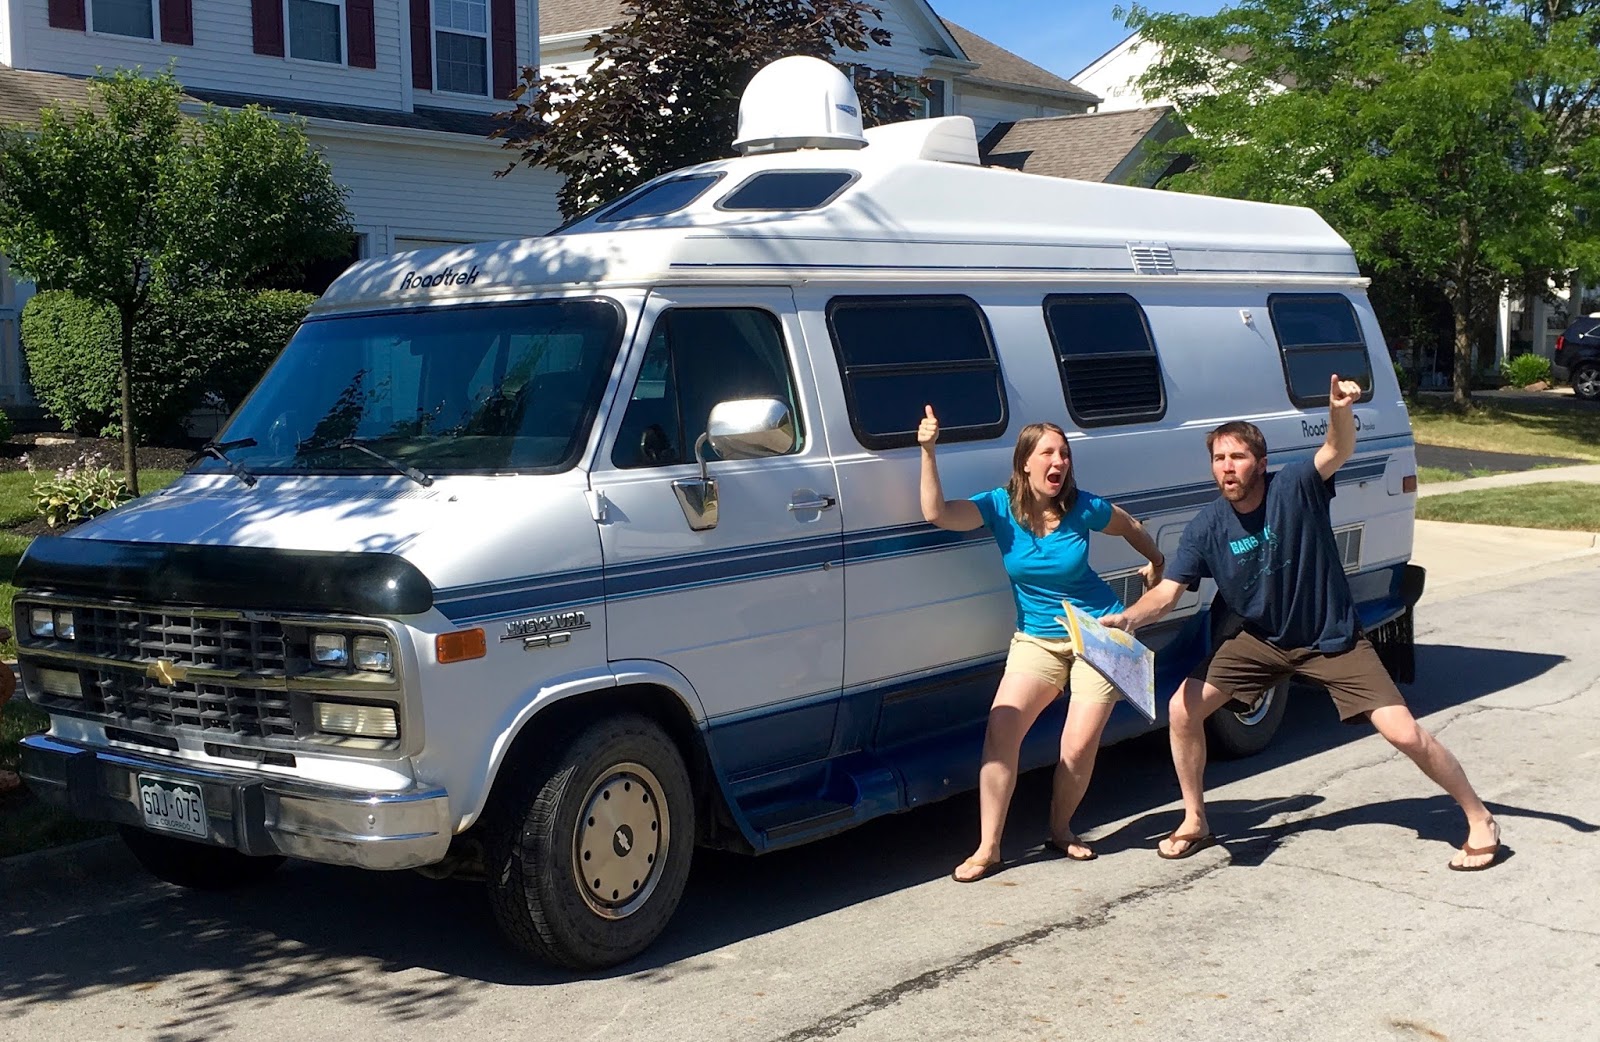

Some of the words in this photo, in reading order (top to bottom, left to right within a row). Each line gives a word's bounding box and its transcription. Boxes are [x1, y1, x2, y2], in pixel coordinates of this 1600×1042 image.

[400, 265, 480, 290] Roadtrek
[1301, 418, 1329, 438] Roadt
[160, 818, 191, 831] COLORADO
